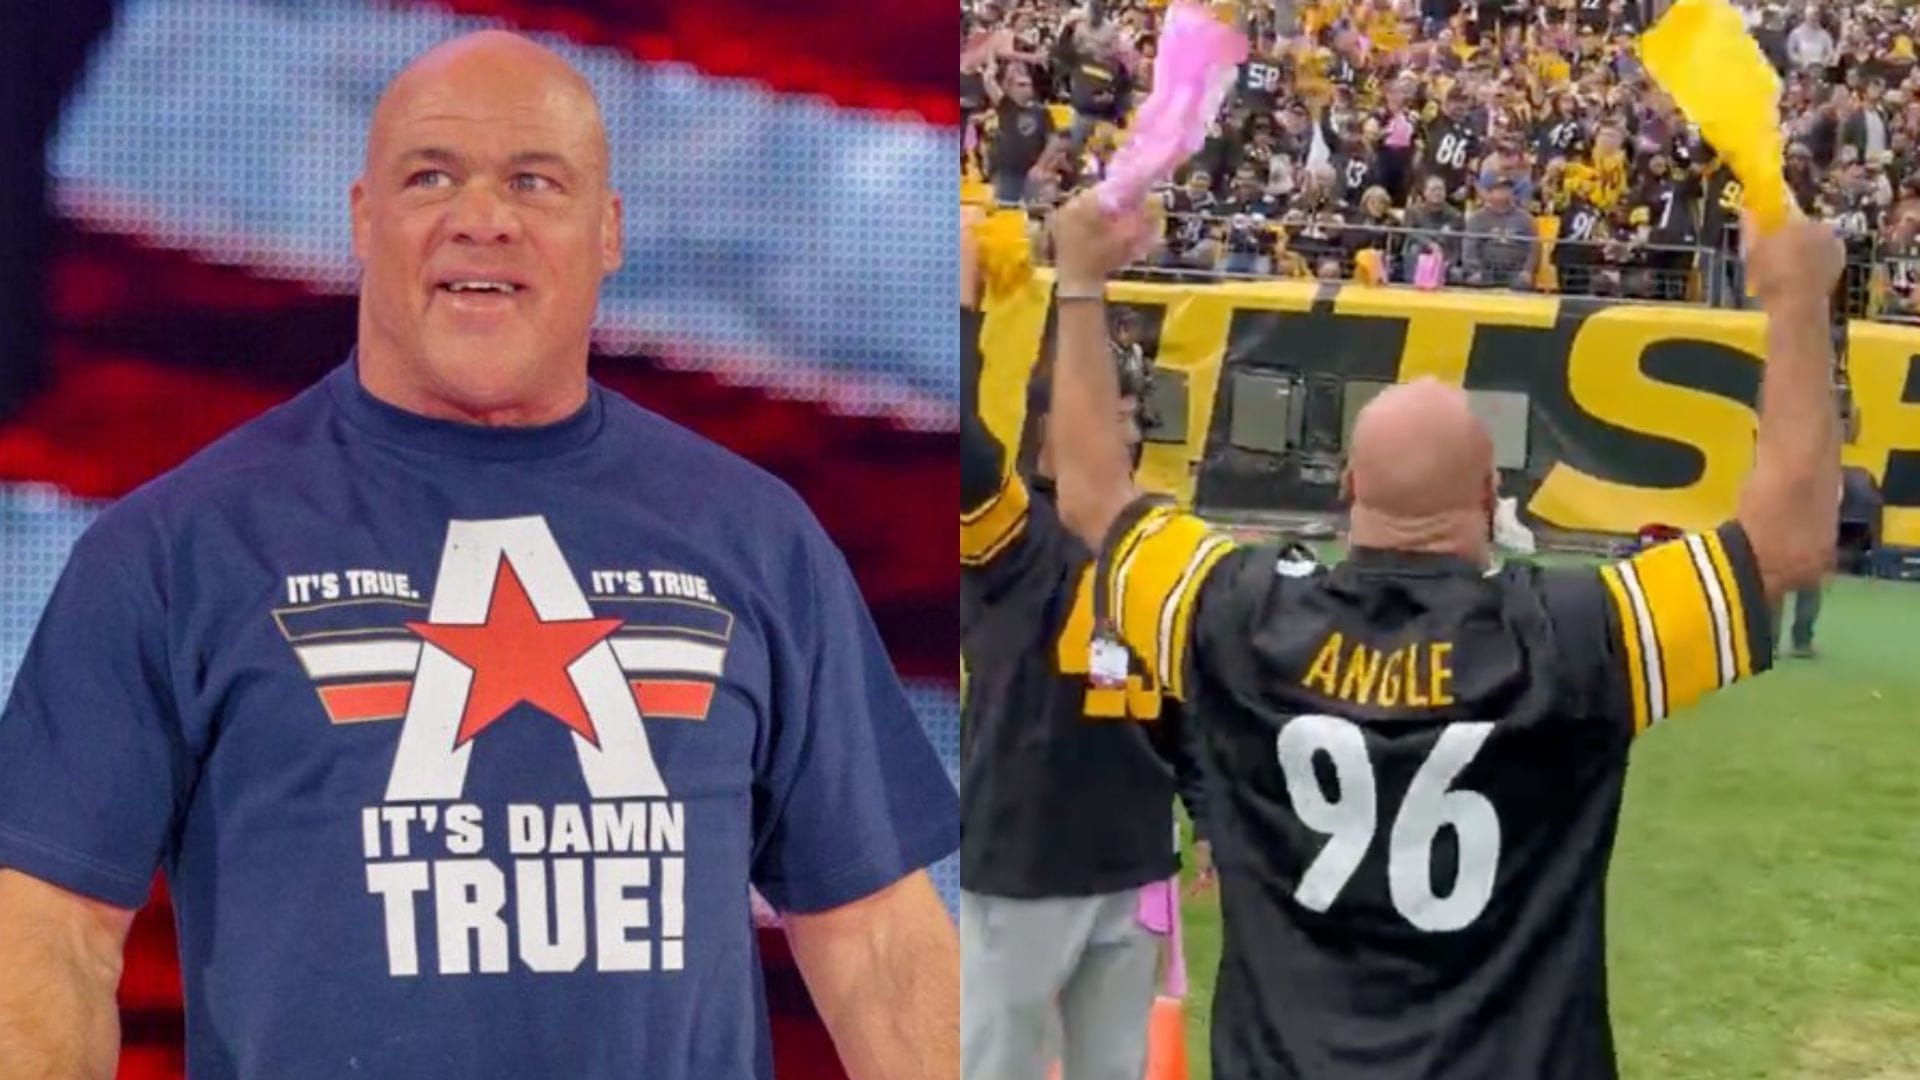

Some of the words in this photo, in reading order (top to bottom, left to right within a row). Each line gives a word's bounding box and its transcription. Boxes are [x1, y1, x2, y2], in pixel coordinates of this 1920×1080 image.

[1436, 133, 1468, 169] 86
[286, 572, 339, 604] IT'S
[345, 569, 420, 599] TRUE.
[591, 570, 645, 594] IT'S
[648, 570, 717, 603] TRUE.
[1302, 631, 1455, 708] ANGLE
[362, 806, 484, 858] IT'S
[508, 802, 685, 855] DAMN
[1277, 714, 1501, 933] 96
[366, 857, 685, 976] TRUE!
